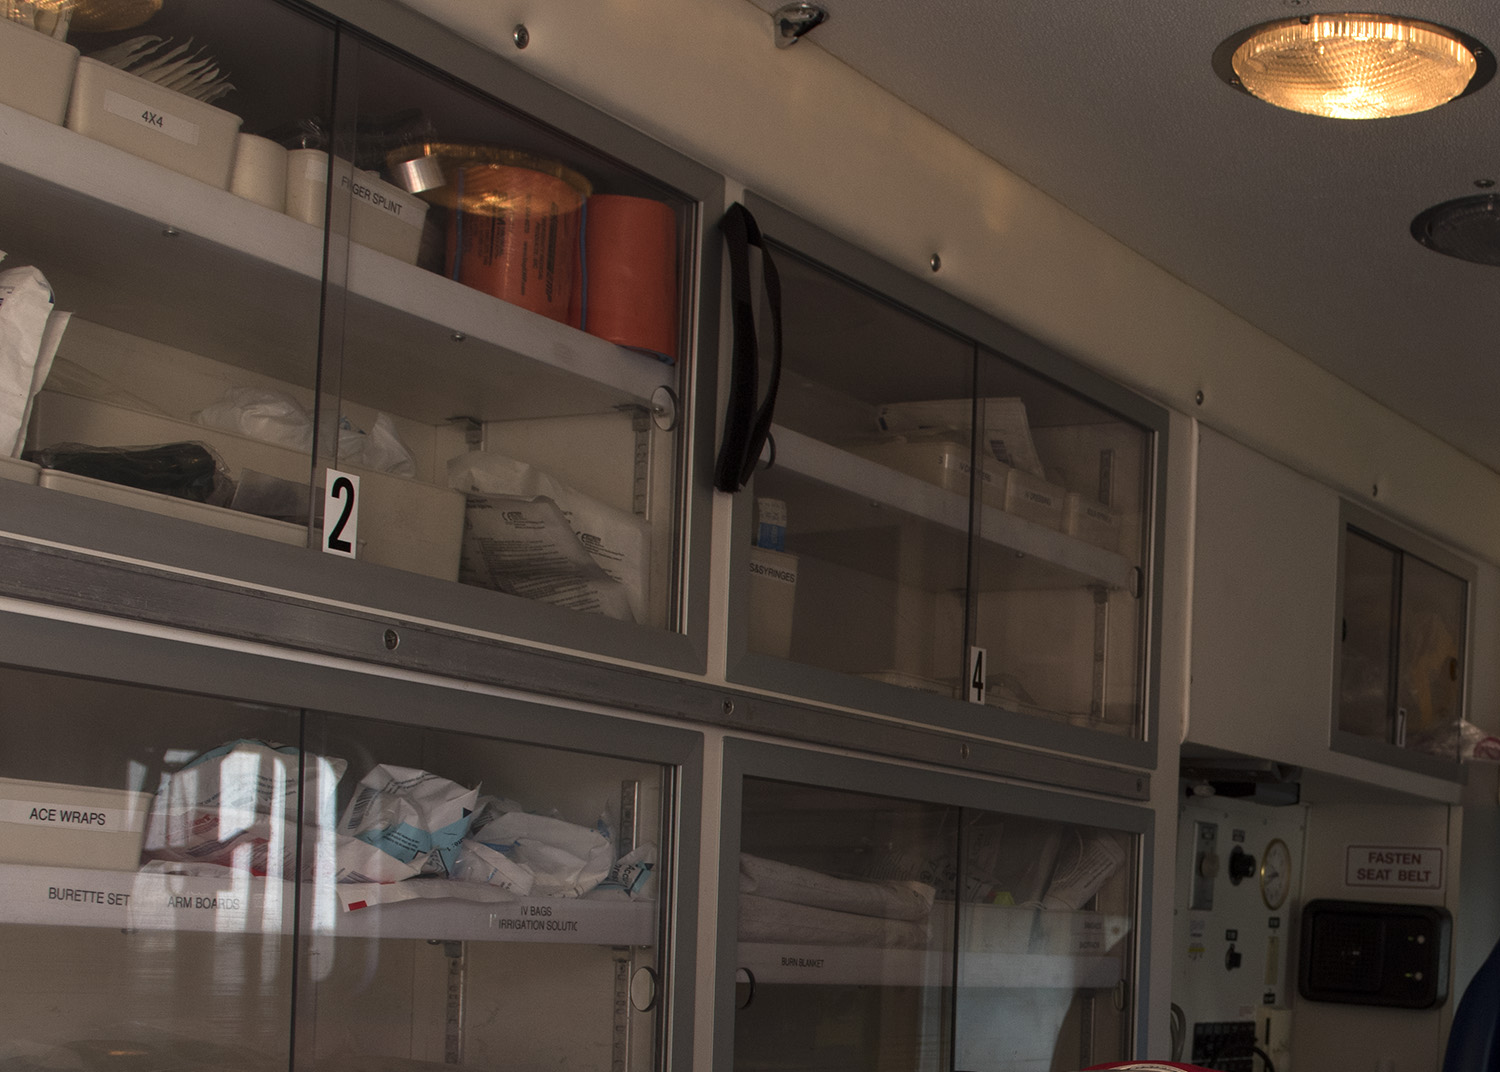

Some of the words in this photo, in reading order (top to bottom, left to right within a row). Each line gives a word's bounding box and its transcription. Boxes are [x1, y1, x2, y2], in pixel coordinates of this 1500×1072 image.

[141, 110, 164, 128] 4X4
[341, 176, 371, 201] FIGER
[372, 193, 402, 216] SPLINT
[328, 476, 355, 553] 2
[749, 562, 796, 583] S&SYRINGES
[972, 650, 984, 702] 4
[1399, 710, 1406, 745] 7
[29, 807, 57, 822] ACE
[59, 810, 106, 826] WRAPS
[1368, 852, 1422, 865] FASTEN
[1356, 868, 1392, 881] SEAT
[1398, 870, 1432, 882] BELT
[48, 887, 105, 904] BURETTE
[107, 893, 131, 906] SET
[167, 896, 192, 908] ARM
[195, 897, 240, 910] BOARDS
[520, 906, 529, 915] IV
[530, 906, 552, 917] BAGS
[498, 919, 545, 931] IRRIGATION
[781, 957, 798, 966] BURN
[798, 958, 825, 968] BLANKET
